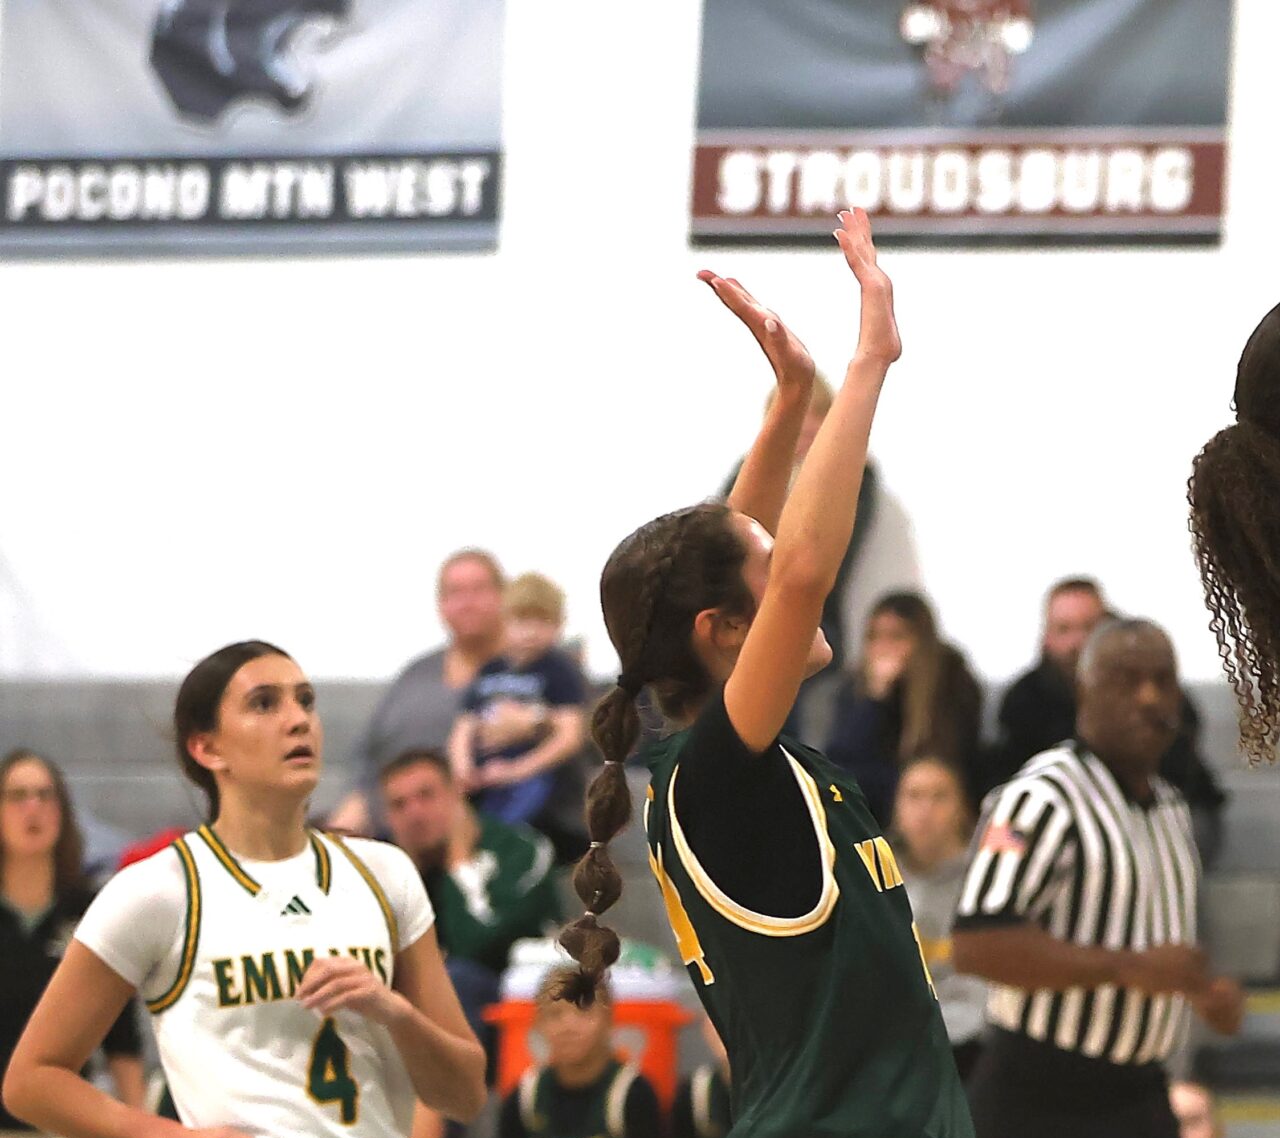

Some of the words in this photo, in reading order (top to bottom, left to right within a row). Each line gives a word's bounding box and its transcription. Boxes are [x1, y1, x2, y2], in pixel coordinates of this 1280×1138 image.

[8, 163, 211, 222] POCONO
[219, 160, 335, 220] MTN
[346, 157, 491, 217] WEST
[718, 147, 1194, 213] STROUDSBURG
[211, 947, 388, 1007] EMMS
[306, 1015, 360, 1127] 4
